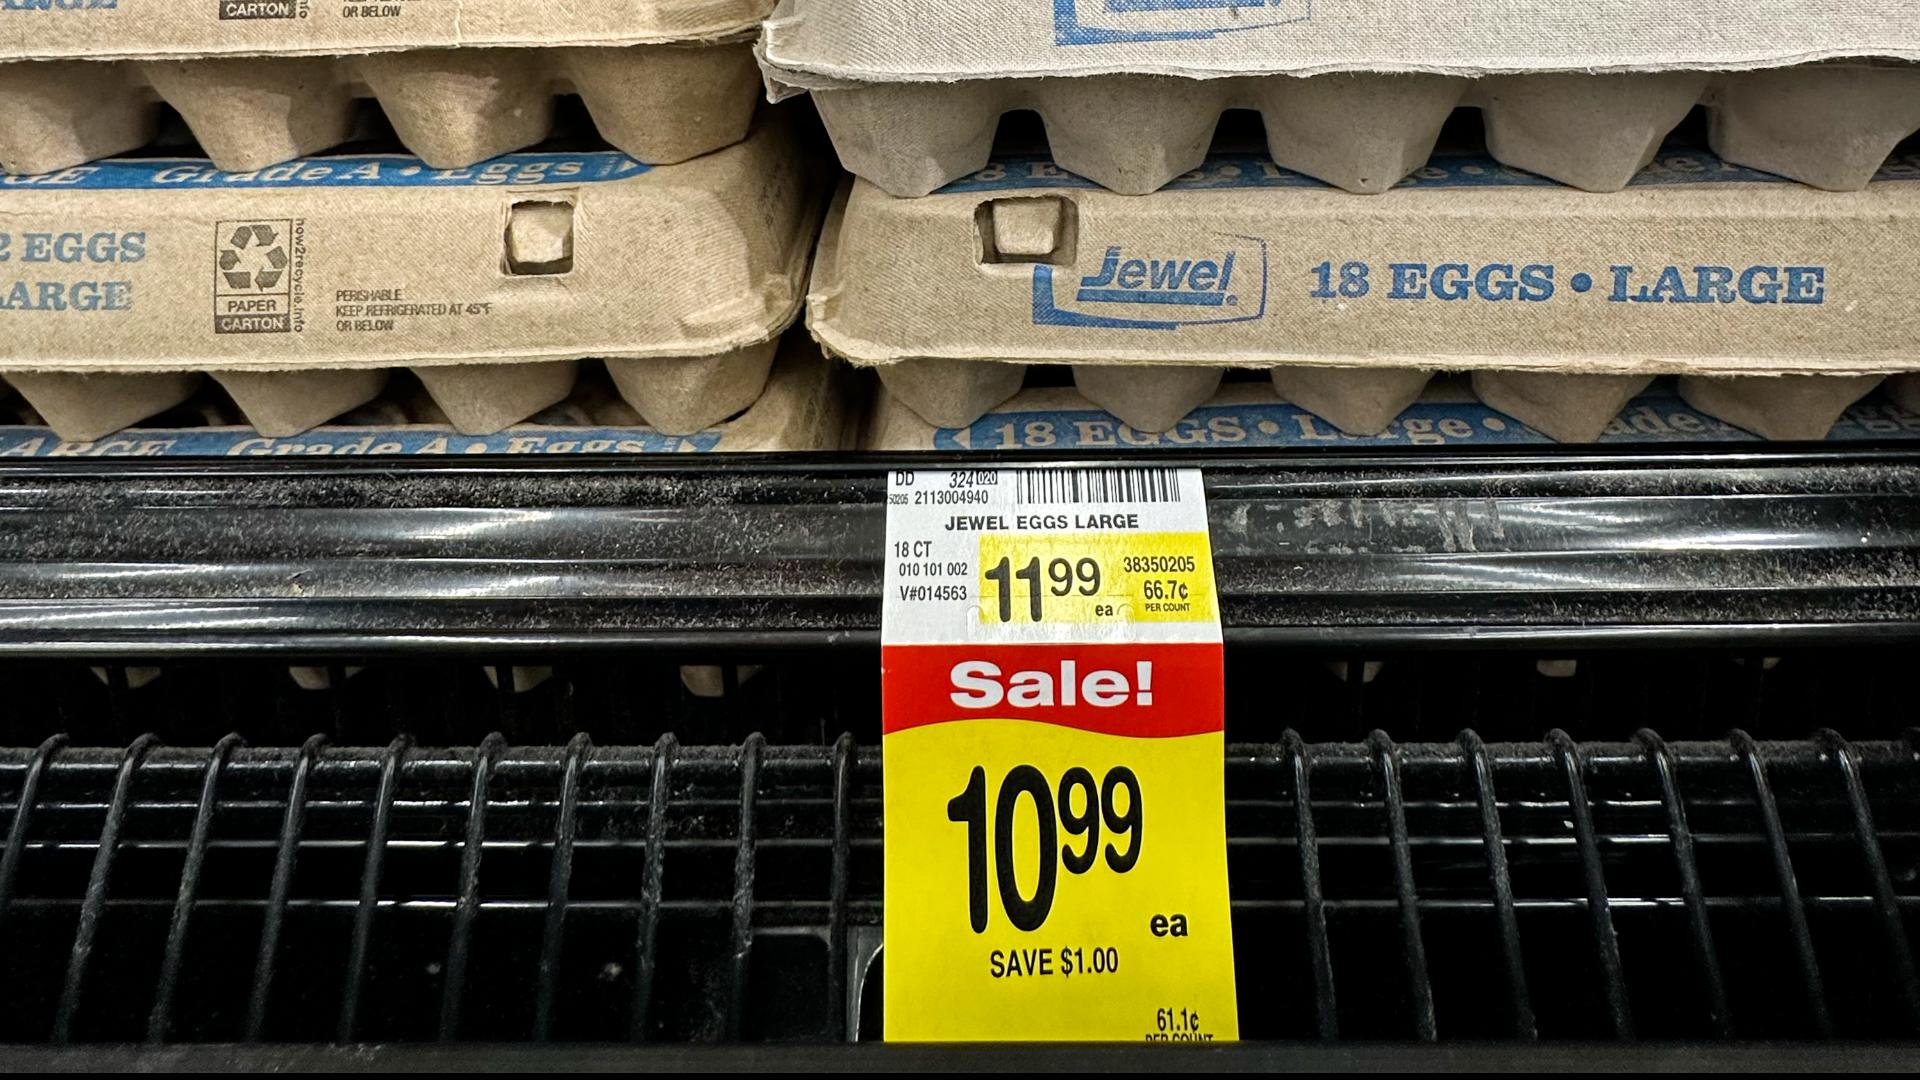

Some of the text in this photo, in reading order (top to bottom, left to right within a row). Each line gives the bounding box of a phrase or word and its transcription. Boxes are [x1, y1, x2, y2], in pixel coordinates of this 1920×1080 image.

[226, 4, 289, 17] CARTON
[343, 5, 401, 18] OR BELOW
[336, 162, 381, 180] A
[22, 231, 146, 263] EGGS
[294, 218, 306, 332] how2recycle.info
[1311, 261, 1825, 304] 18 EGGS LARGE
[0, 280, 133, 311] ARGE
[336, 289, 402, 301] PERISHABLE
[227, 299, 277, 313] PAPER
[336, 305, 363, 317] KEEP
[366, 304, 446, 317] REFRIGERATED
[449, 303, 464, 315] AT
[221, 316, 285, 331] CARTON
[336, 319, 394, 332] OR BELOW
[996, 422, 1057, 449] 18
[1073, 416, 1247, 446] EGGS
[414, 437, 449, 455] A
[896, 471, 914, 486] DD
[949, 471, 998, 488] 324 020
[915, 490, 989, 505] 2113004940
[945, 514, 1139, 531] JEWEL EGGS LARGE
[894, 541, 932, 558] 18 CT
[899, 562, 968, 577] 010 101 002
[1124, 556, 1195, 573] 38350205
[900, 585, 967, 602] V#014563
[1143, 580, 1189, 602] 66.7¢
[1095, 604, 1114, 617] ea
[1145, 602, 1190, 612] PER COUNT
[949, 659, 1153, 709] Sale!
[1150, 913, 1188, 937] ea
[990, 947, 1118, 978] SAVE $1.00
[1157, 1008, 1199, 1032] 61.1¢
